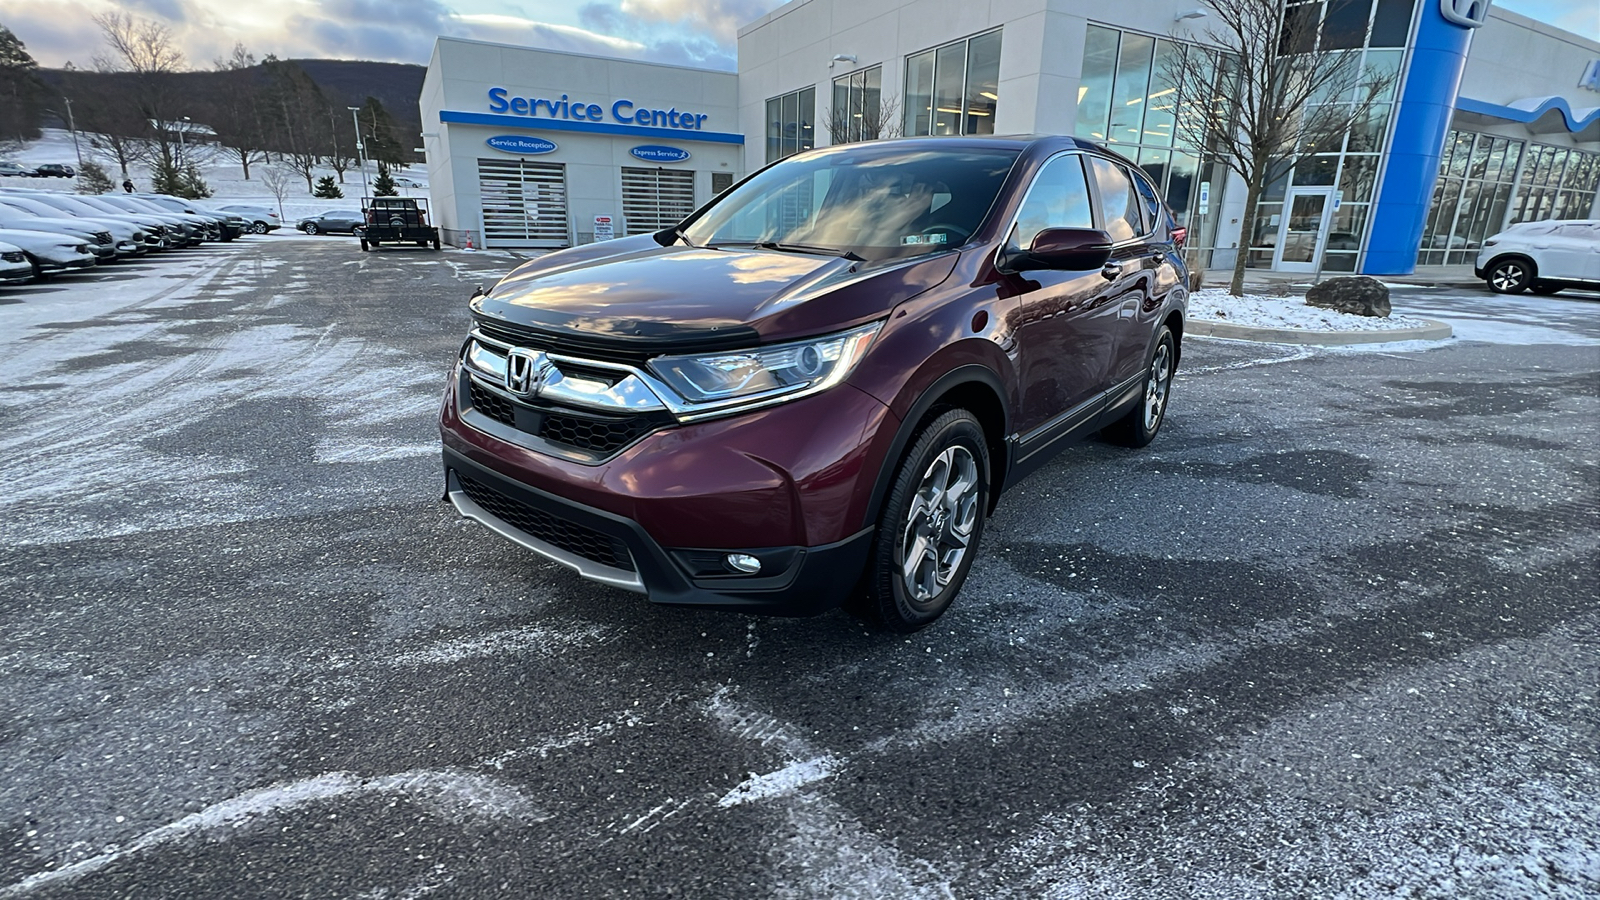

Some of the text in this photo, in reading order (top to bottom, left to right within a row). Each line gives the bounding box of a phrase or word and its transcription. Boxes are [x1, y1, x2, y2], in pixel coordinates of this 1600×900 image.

[488, 87, 708, 130] Service Center
[490, 138, 553, 150] Service Reception
[633, 148, 679, 158] Express Service
